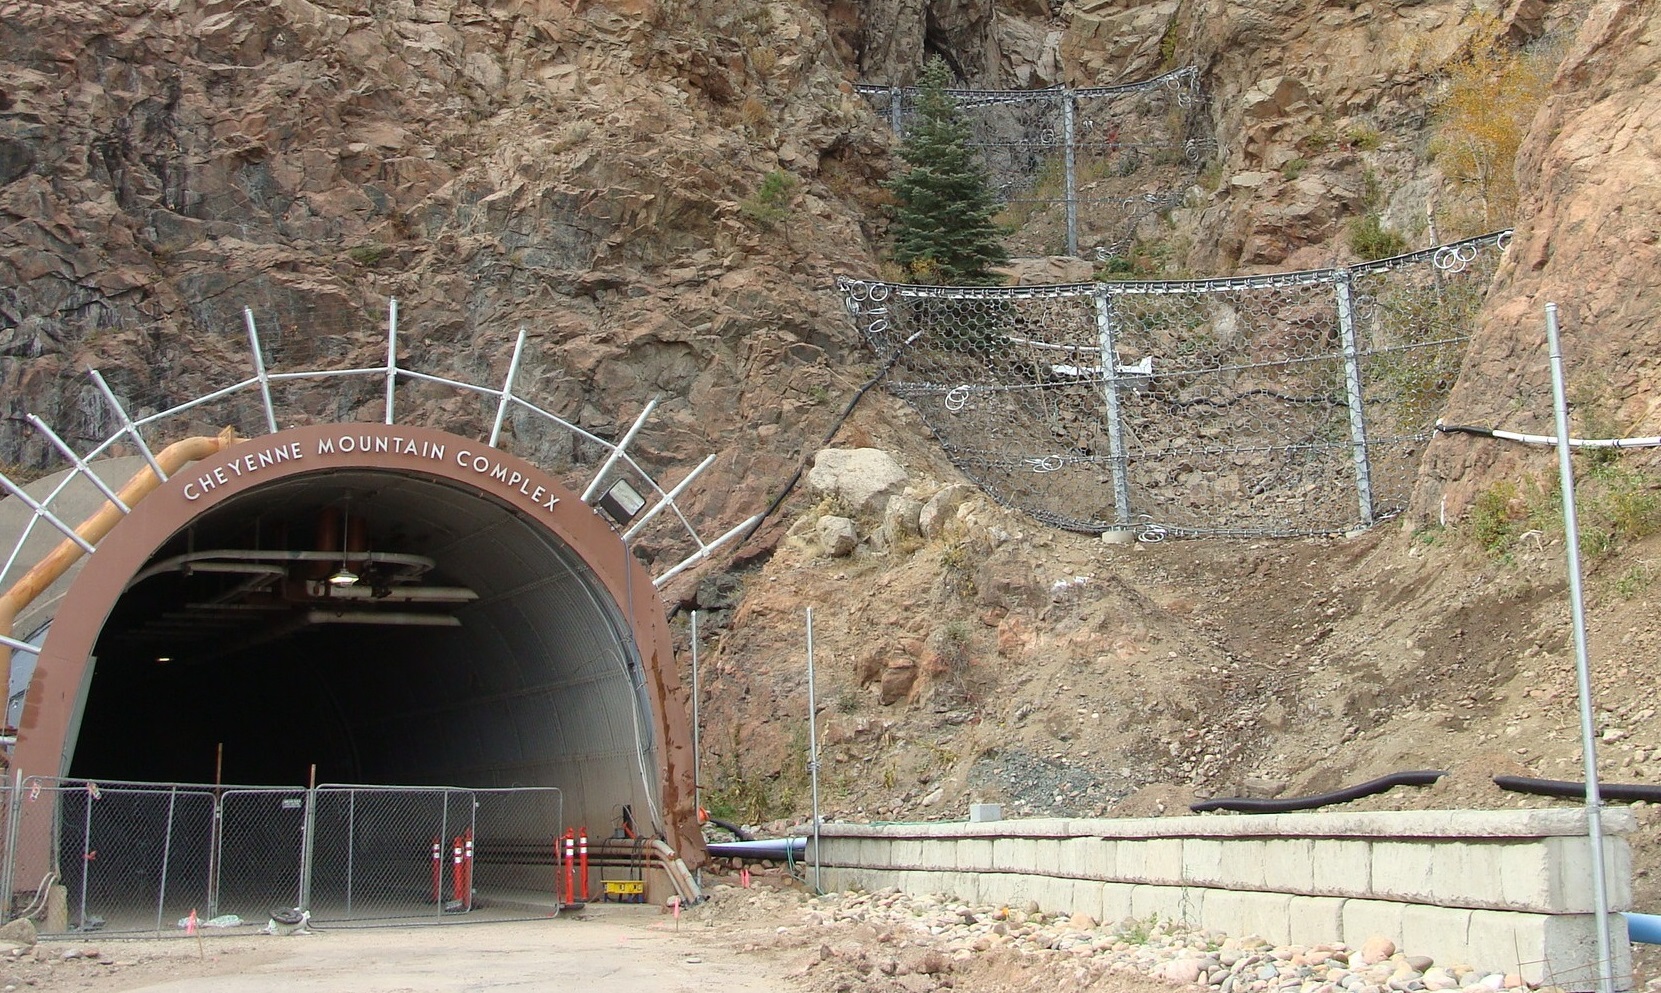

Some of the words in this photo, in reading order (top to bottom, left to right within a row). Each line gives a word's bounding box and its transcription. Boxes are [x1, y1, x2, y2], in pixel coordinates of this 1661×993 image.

[183, 442, 303, 501] CHEYENNE
[317, 435, 445, 460] MOUNTAIN
[456, 450, 561, 513] COMPLEX
